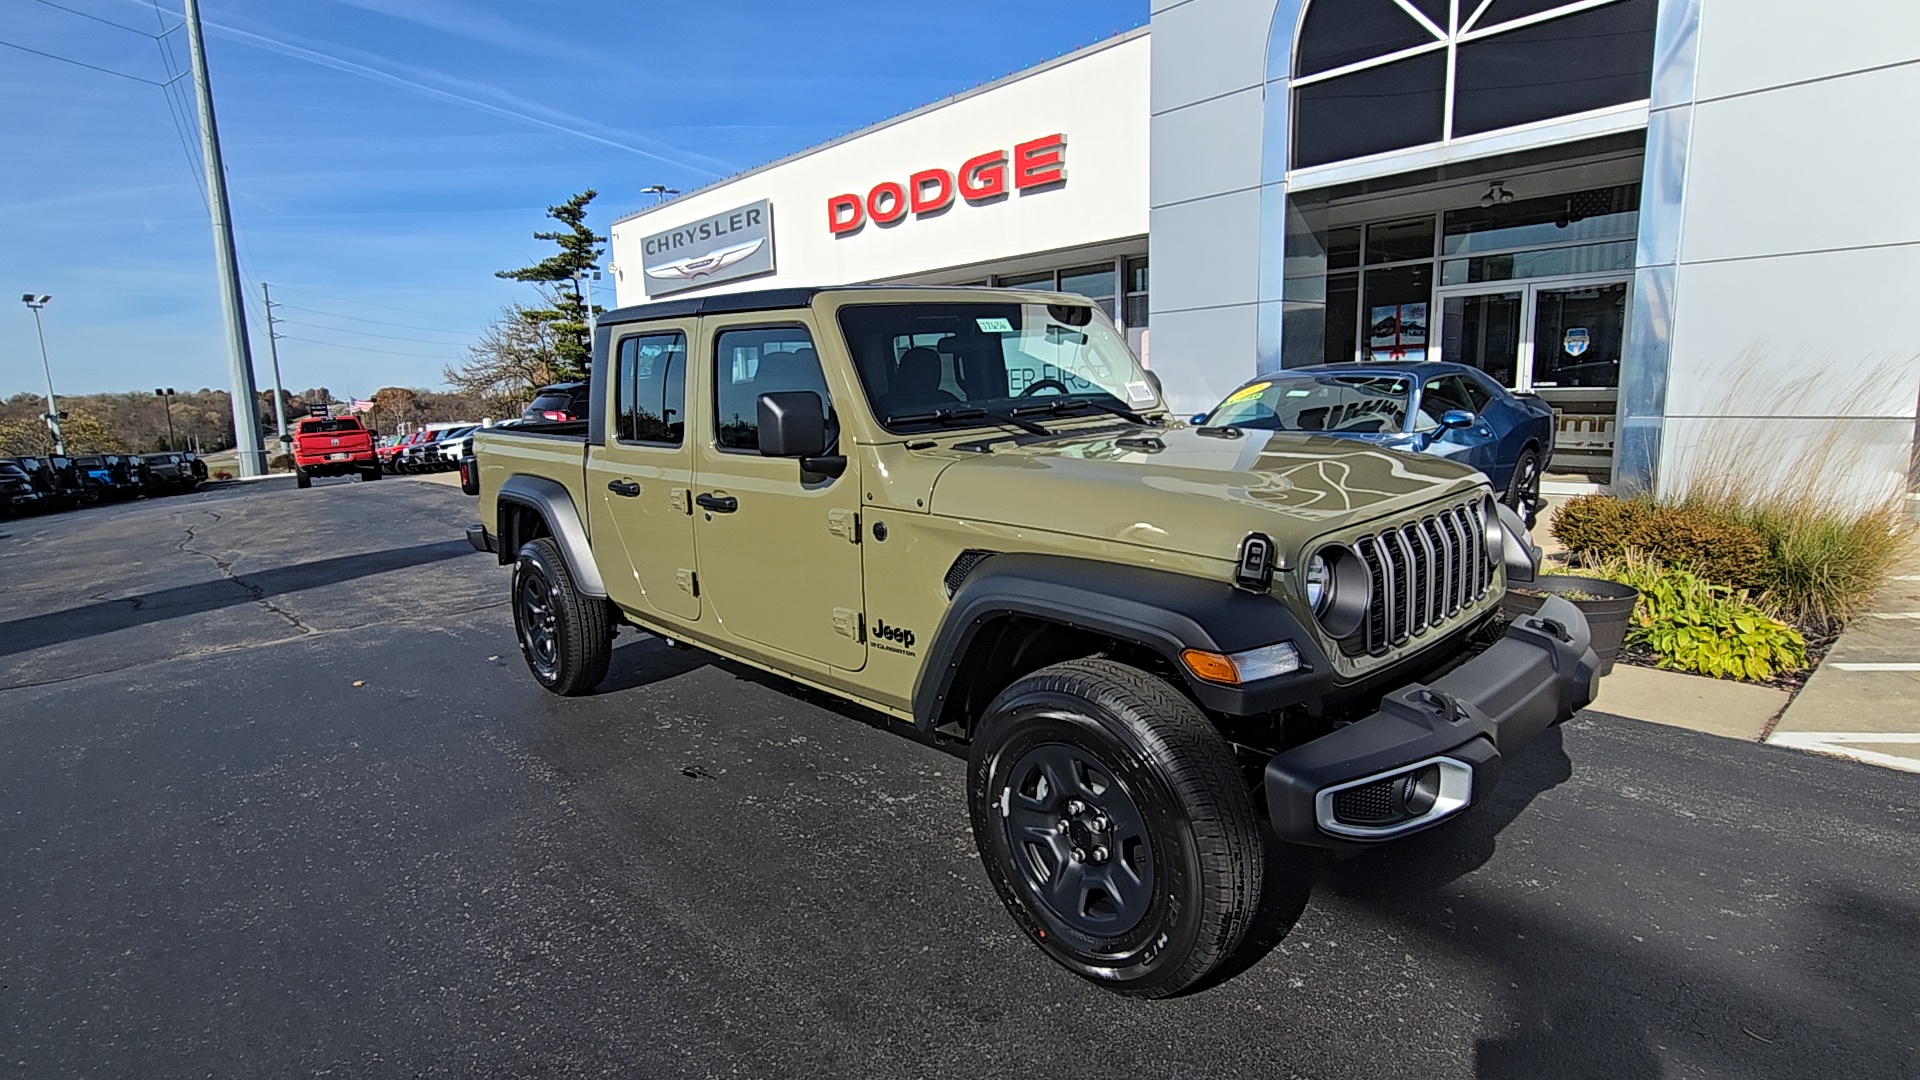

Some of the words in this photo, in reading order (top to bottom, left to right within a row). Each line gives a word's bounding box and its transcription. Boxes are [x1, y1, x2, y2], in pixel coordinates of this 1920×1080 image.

[828, 133, 1062, 233] DODGE
[645, 208, 761, 255] CHRYSLER
[872, 618, 915, 649] Jeep
[877, 643, 917, 658] GLADIATOR
